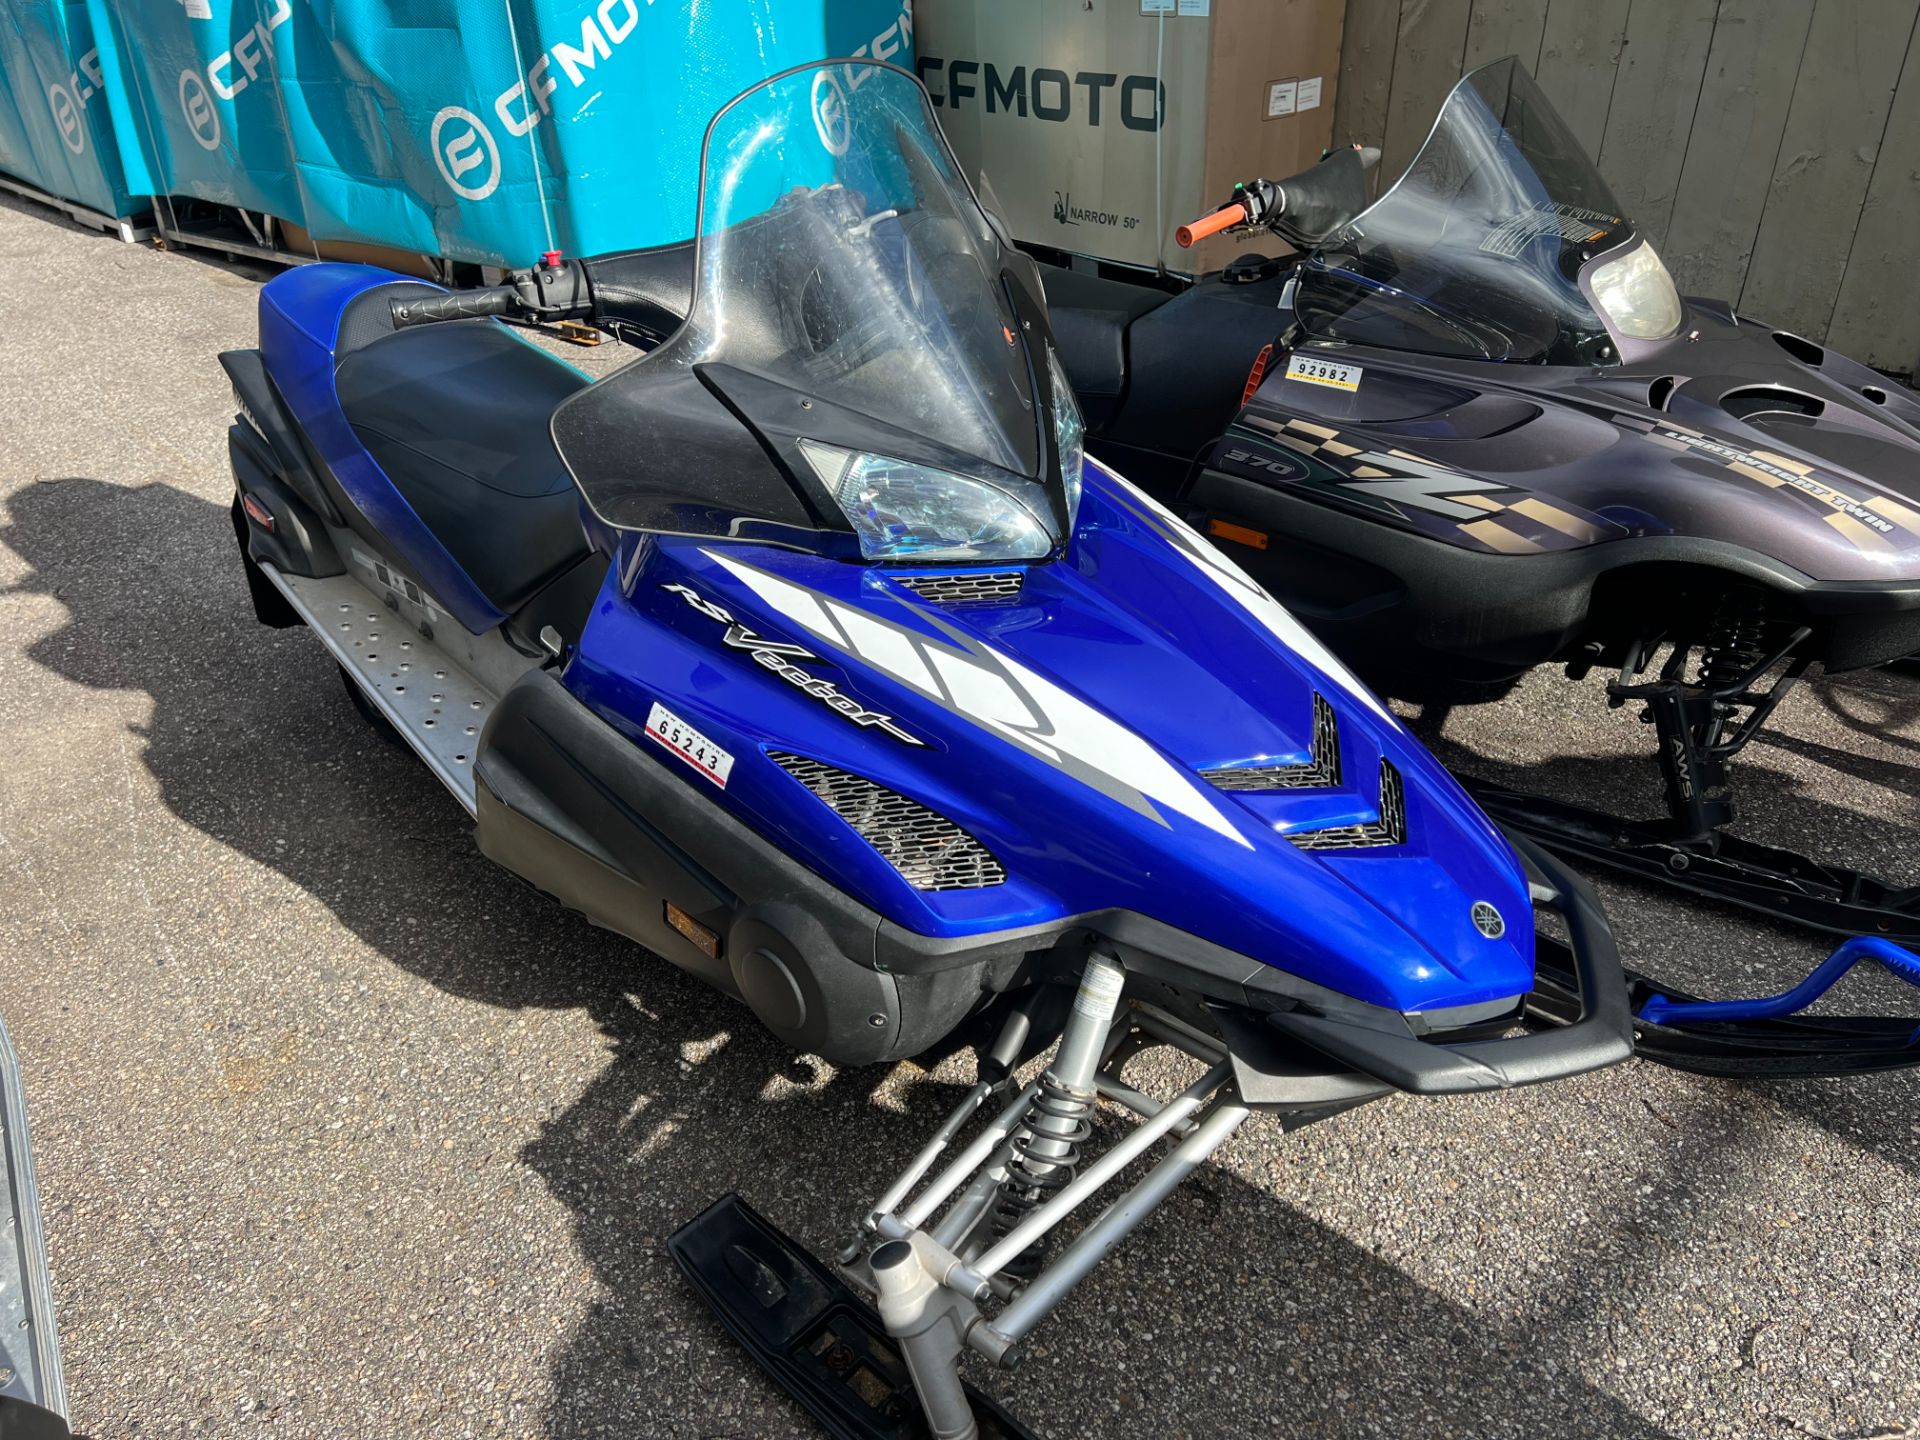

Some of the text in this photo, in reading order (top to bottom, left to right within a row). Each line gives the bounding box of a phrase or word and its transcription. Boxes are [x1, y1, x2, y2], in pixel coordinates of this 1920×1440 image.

[495, 0, 655, 137] CFMO
[917, 56, 1166, 132] CFMOTO
[1070, 207, 1119, 226] NARROW
[1298, 363, 1348, 382] 92982
[1224, 448, 1295, 476] 370
[1664, 431, 1896, 533] LIGHTWEIGHT TWIN
[661, 583, 925, 746] RS Vector
[659, 720, 718, 770] 65243
[1672, 738, 1694, 801] AWS
